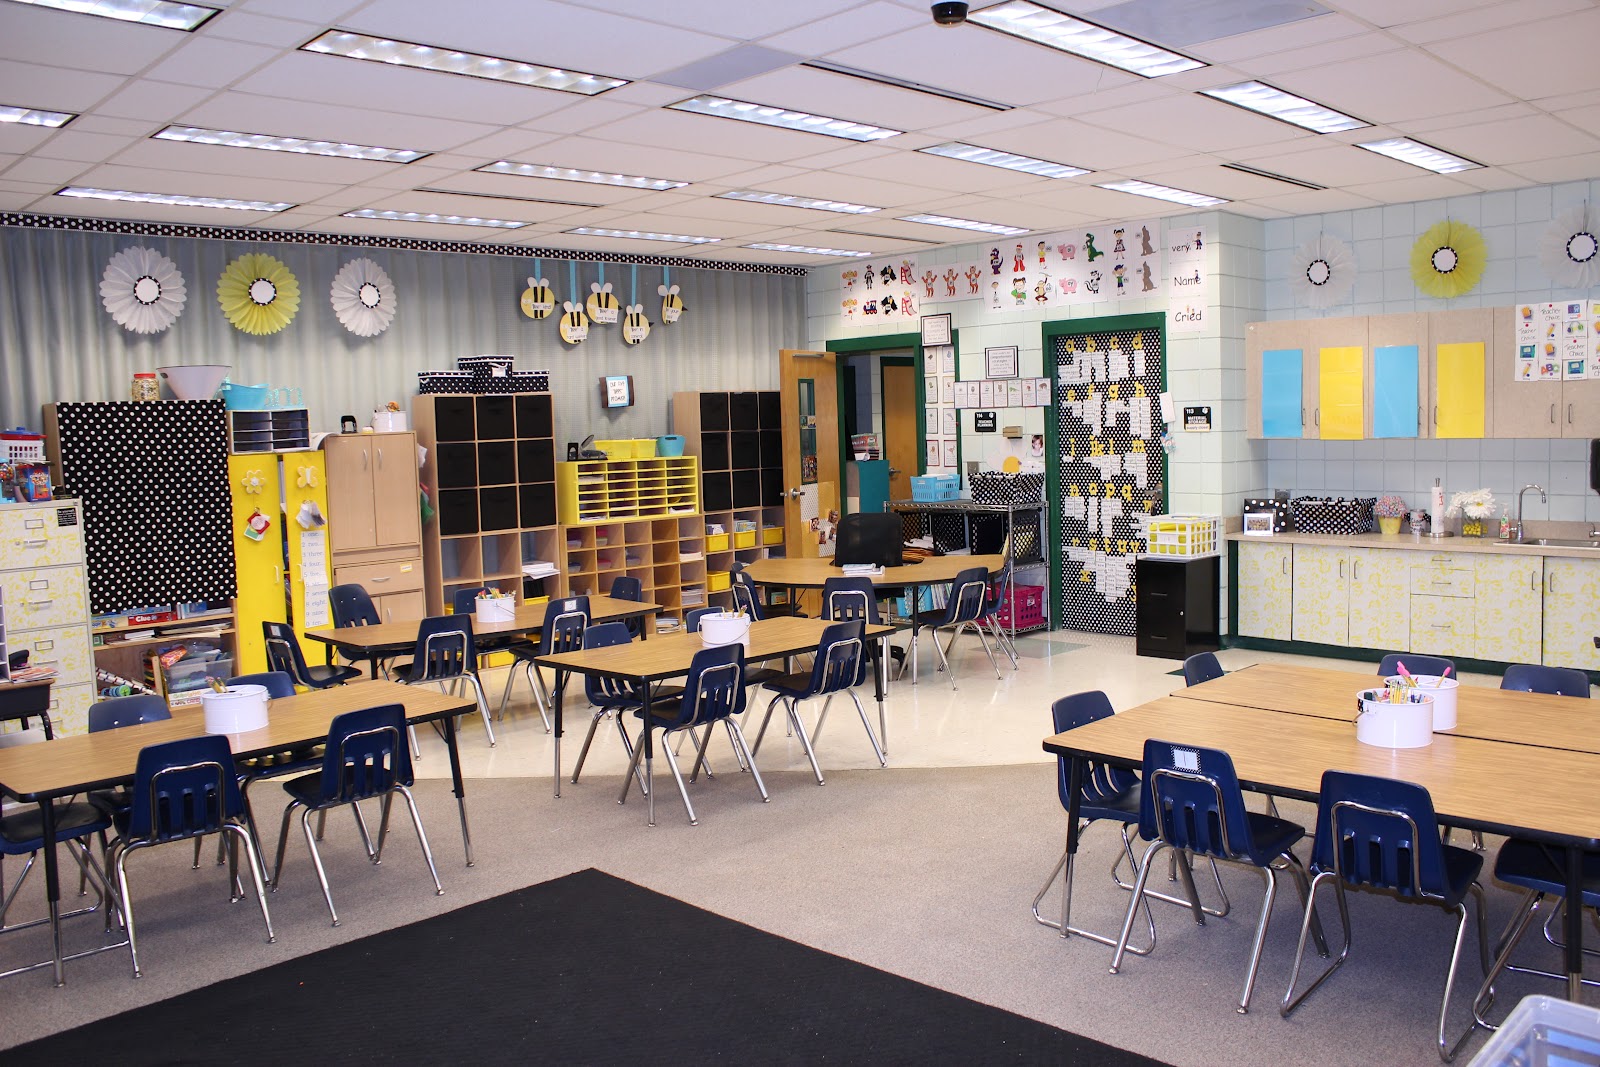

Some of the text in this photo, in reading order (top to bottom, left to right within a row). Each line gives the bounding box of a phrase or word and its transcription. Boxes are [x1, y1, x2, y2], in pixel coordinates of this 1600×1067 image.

[1171, 242, 1191, 253] very
[1174, 276, 1202, 287] Name
[1174, 310, 1202, 323] Cried
